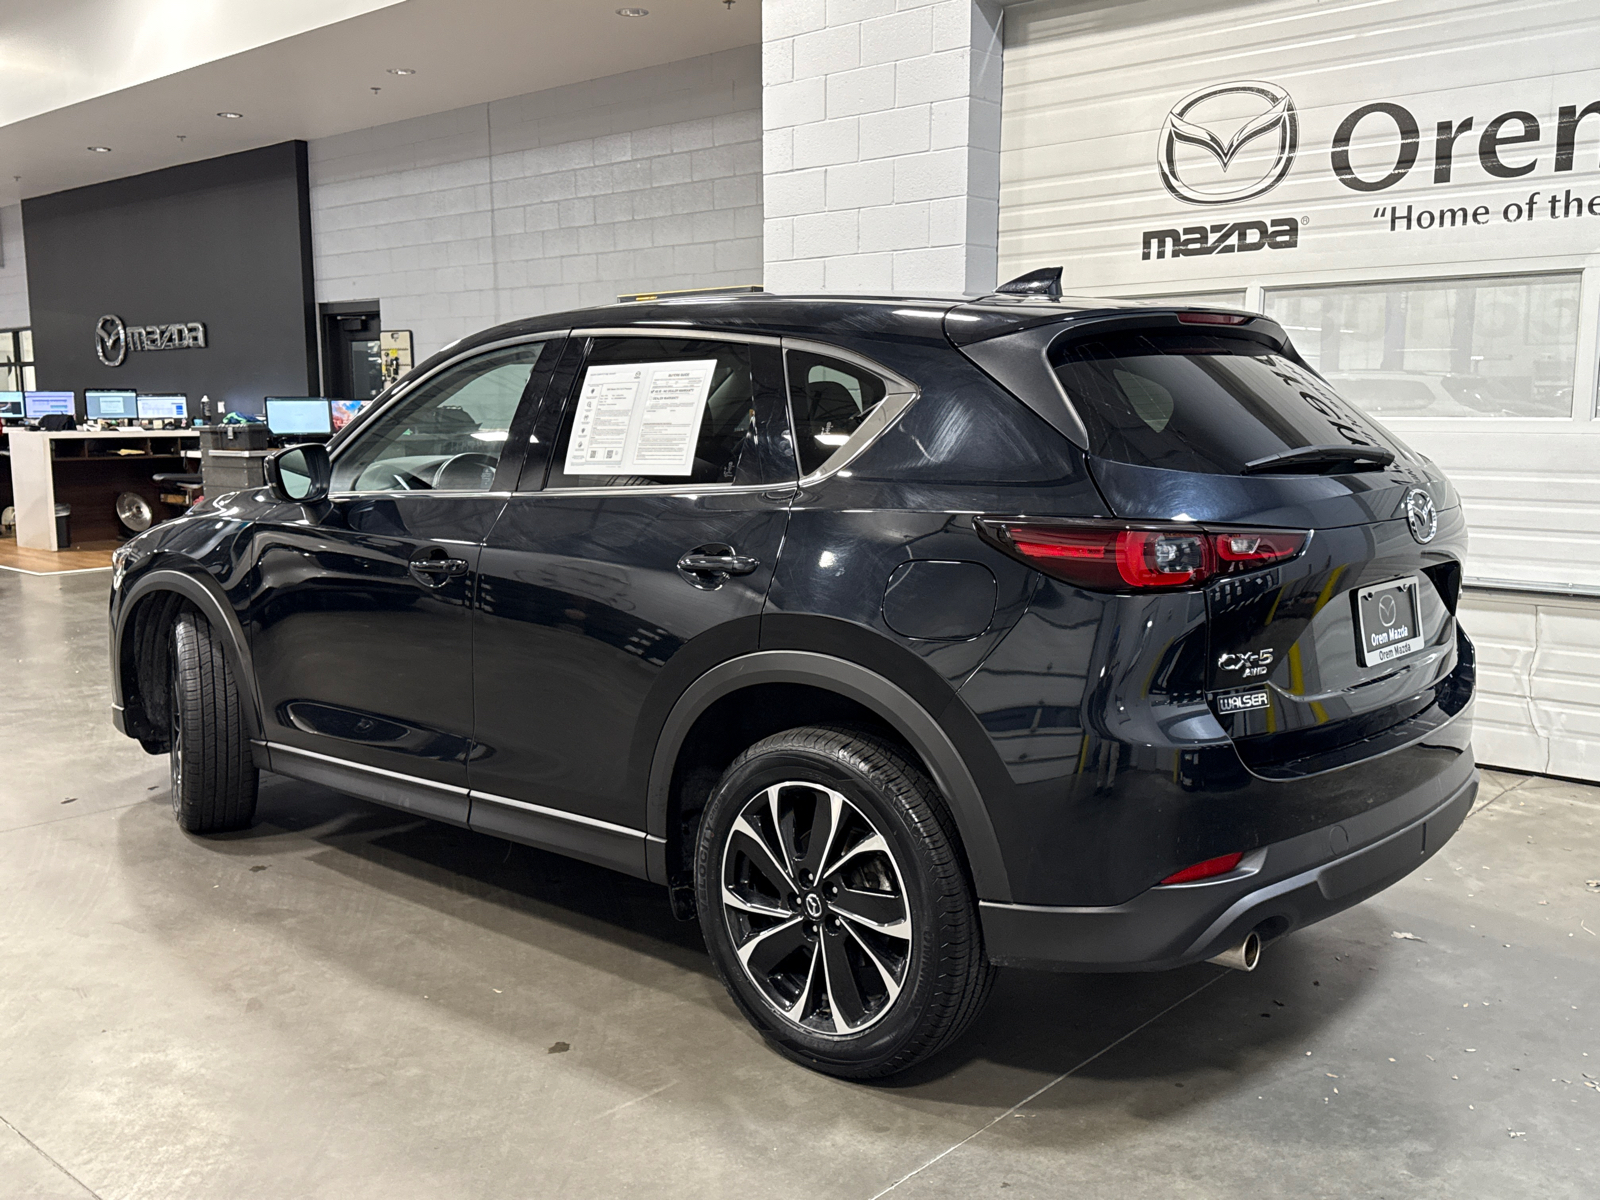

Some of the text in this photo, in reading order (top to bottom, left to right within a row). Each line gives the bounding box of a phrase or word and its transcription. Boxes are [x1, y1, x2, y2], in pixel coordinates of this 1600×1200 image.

[1502, 191, 1541, 223] of
[1371, 625, 1409, 646] Orem Mazda
[1218, 648, 1274, 670] CX-5
[1379, 643, 1412, 661] Orem Mazda
[1220, 692, 1268, 711] WALSER
